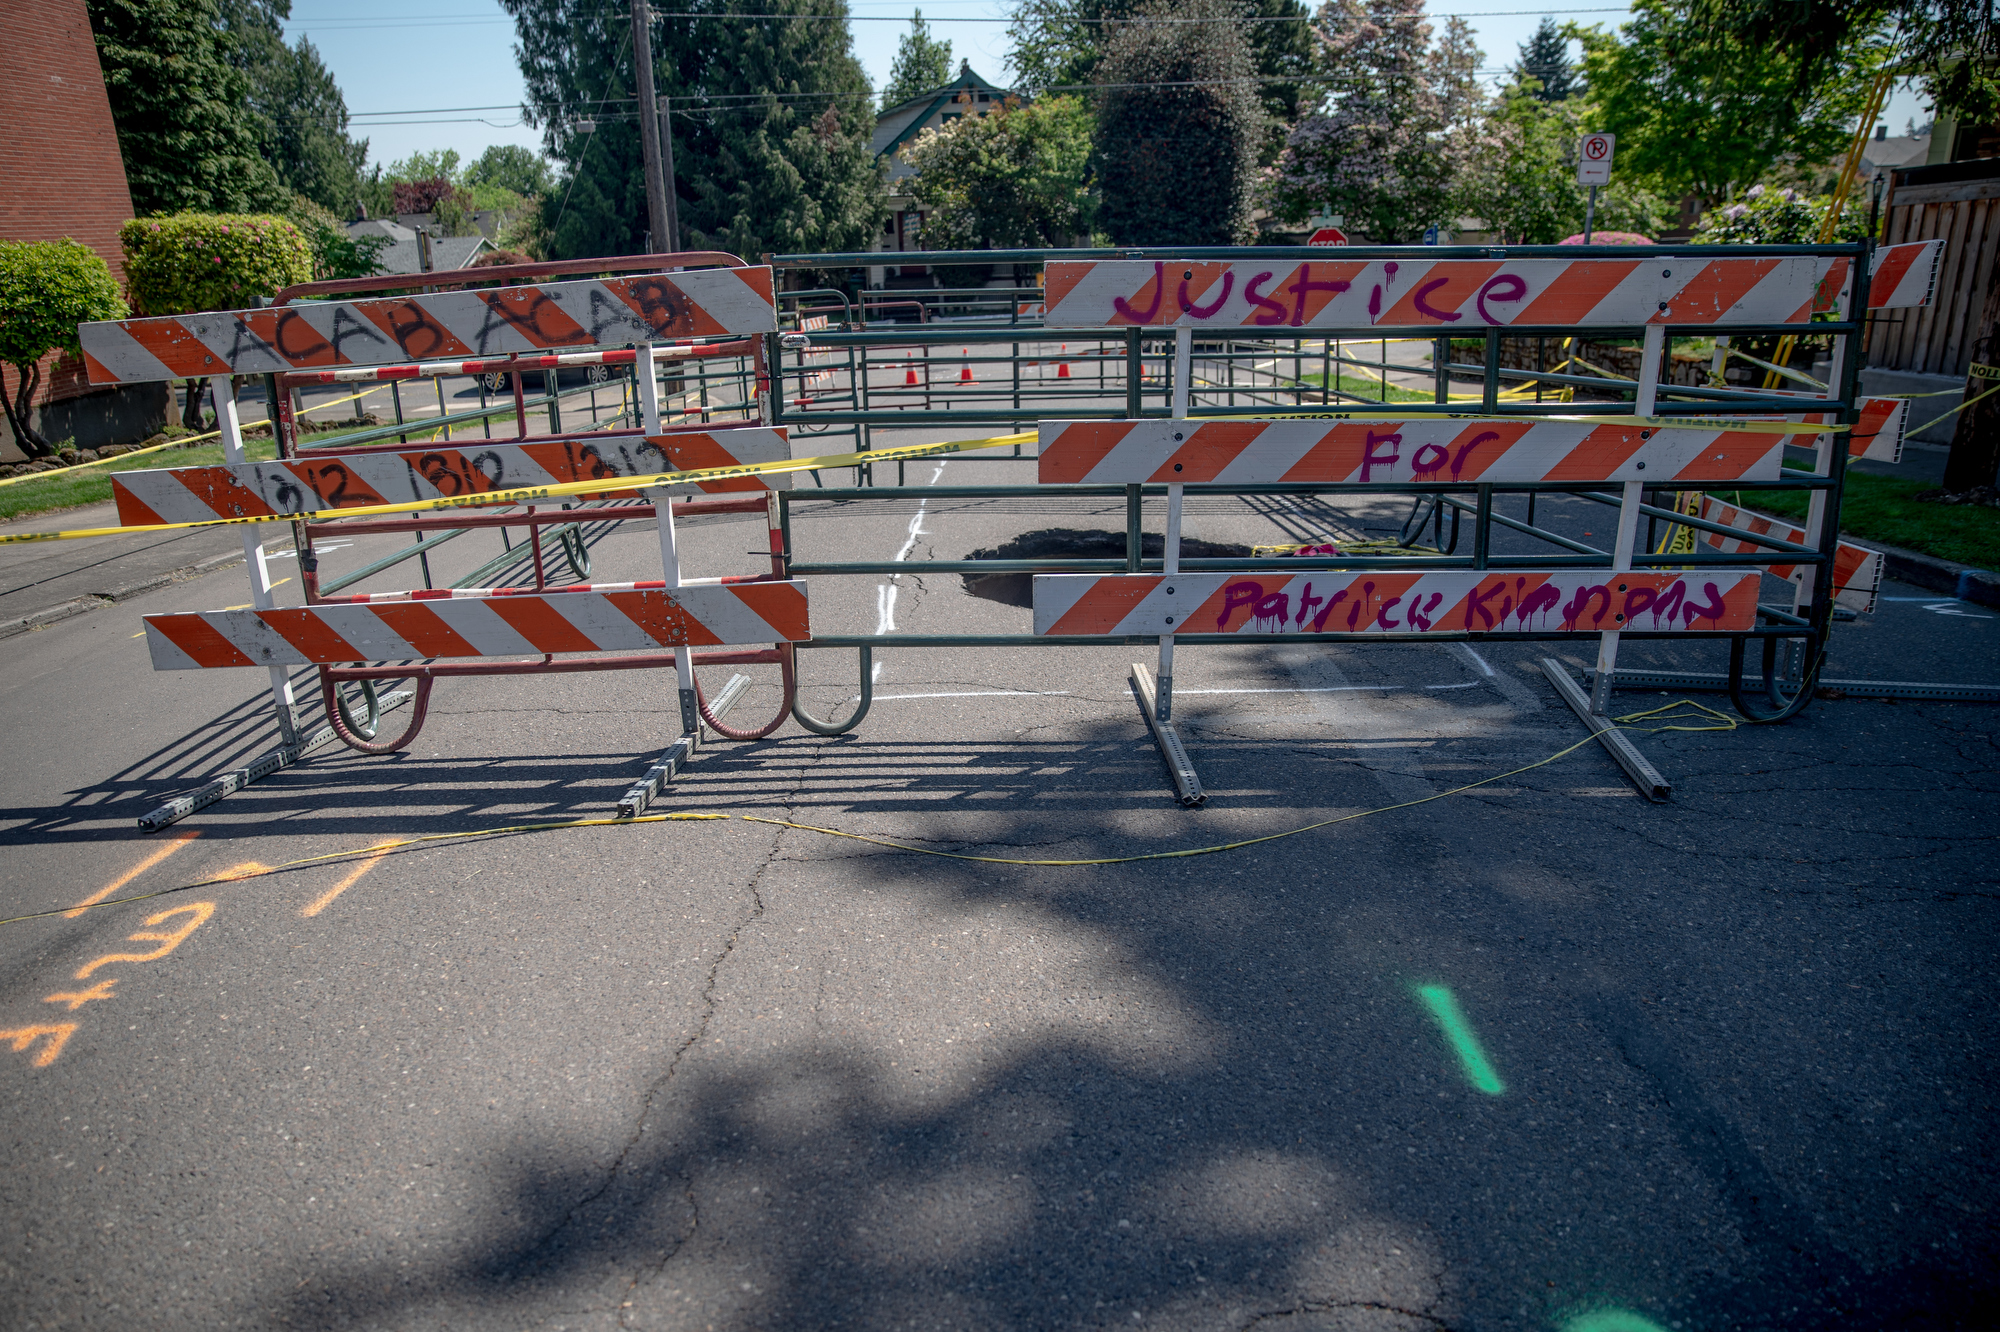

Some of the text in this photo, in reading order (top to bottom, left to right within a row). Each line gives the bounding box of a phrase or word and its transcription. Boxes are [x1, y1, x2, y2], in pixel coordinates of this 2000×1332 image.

[226, 277, 679, 370] ACAB ACAB
[1358, 429, 1500, 483] For
[1216, 580, 1444, 633] Patrick
